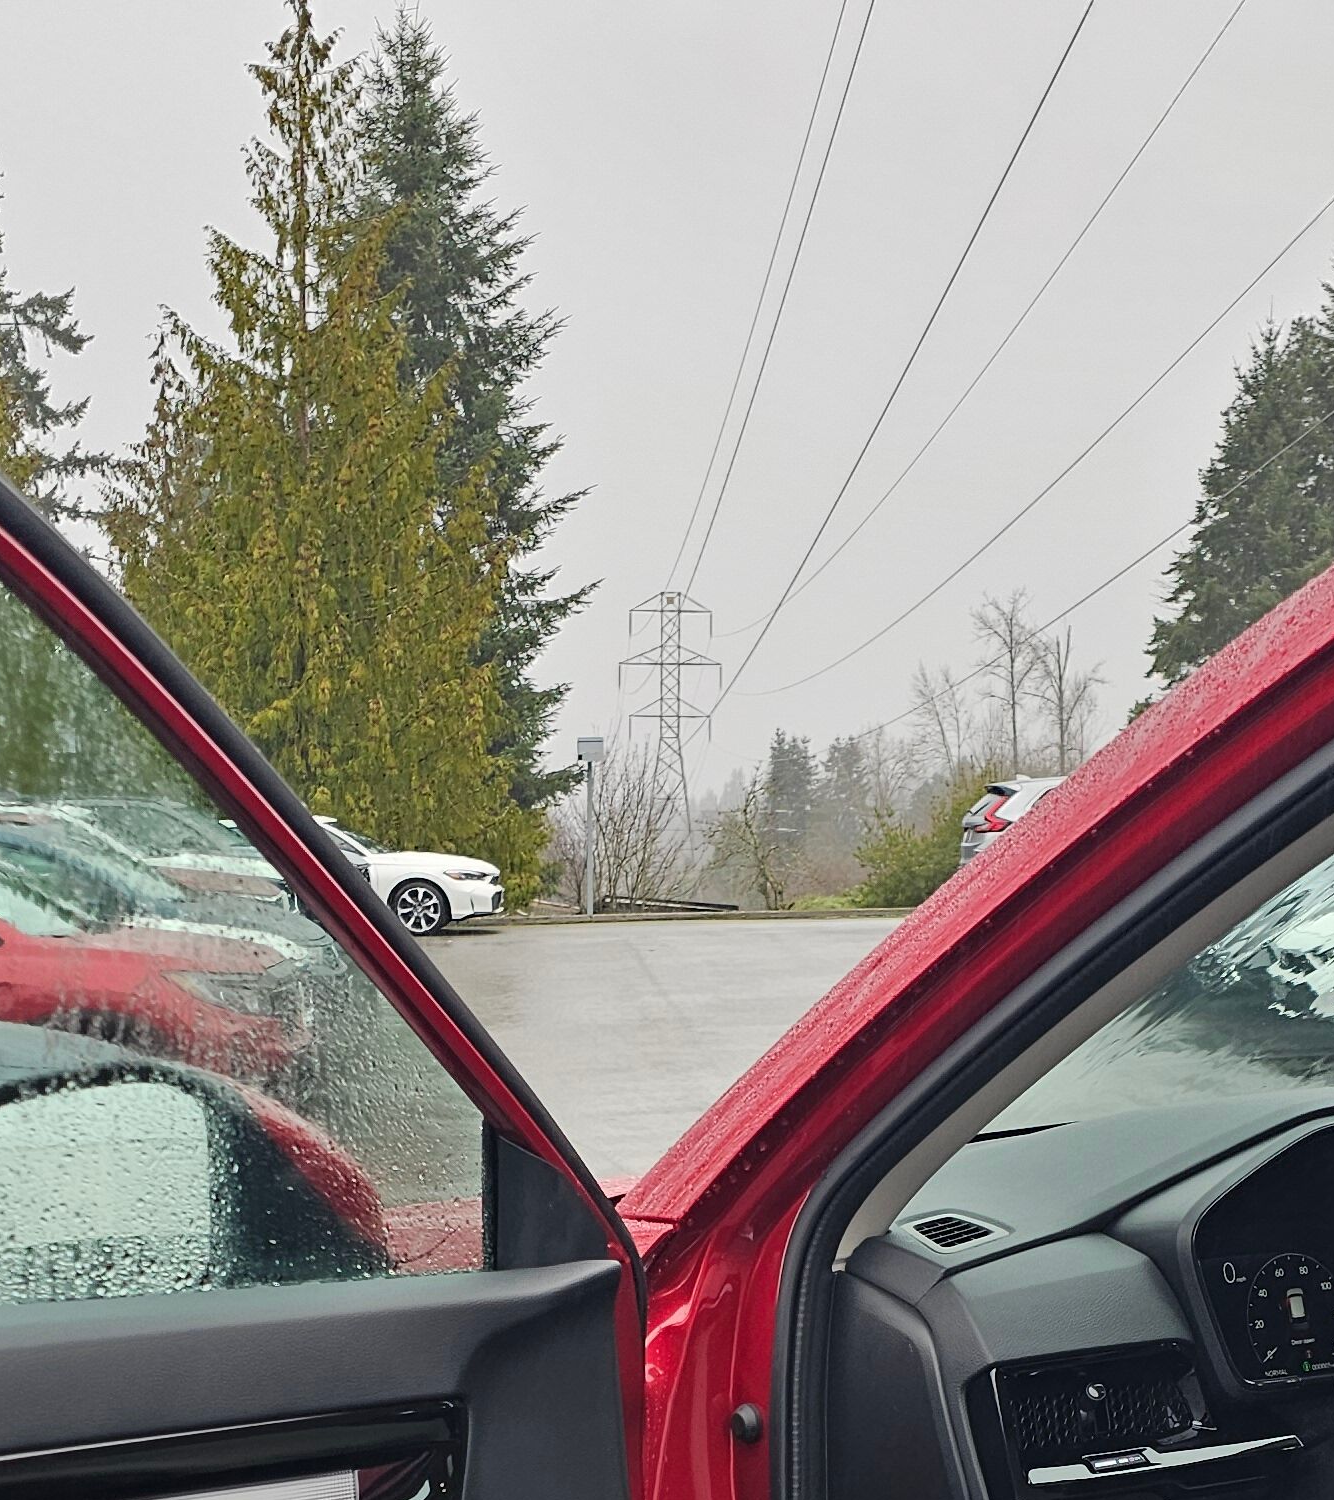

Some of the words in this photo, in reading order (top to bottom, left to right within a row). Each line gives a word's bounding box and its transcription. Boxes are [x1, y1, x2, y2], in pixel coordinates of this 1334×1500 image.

[1223, 1261, 1236, 1284] 0
[1274, 1267, 1285, 1278] 60
[1299, 1266, 1309, 1275] 80
[1320, 1281, 1332, 1291] 100
[1258, 1288, 1268, 1298] 40
[1254, 1319, 1265, 1329] 20
